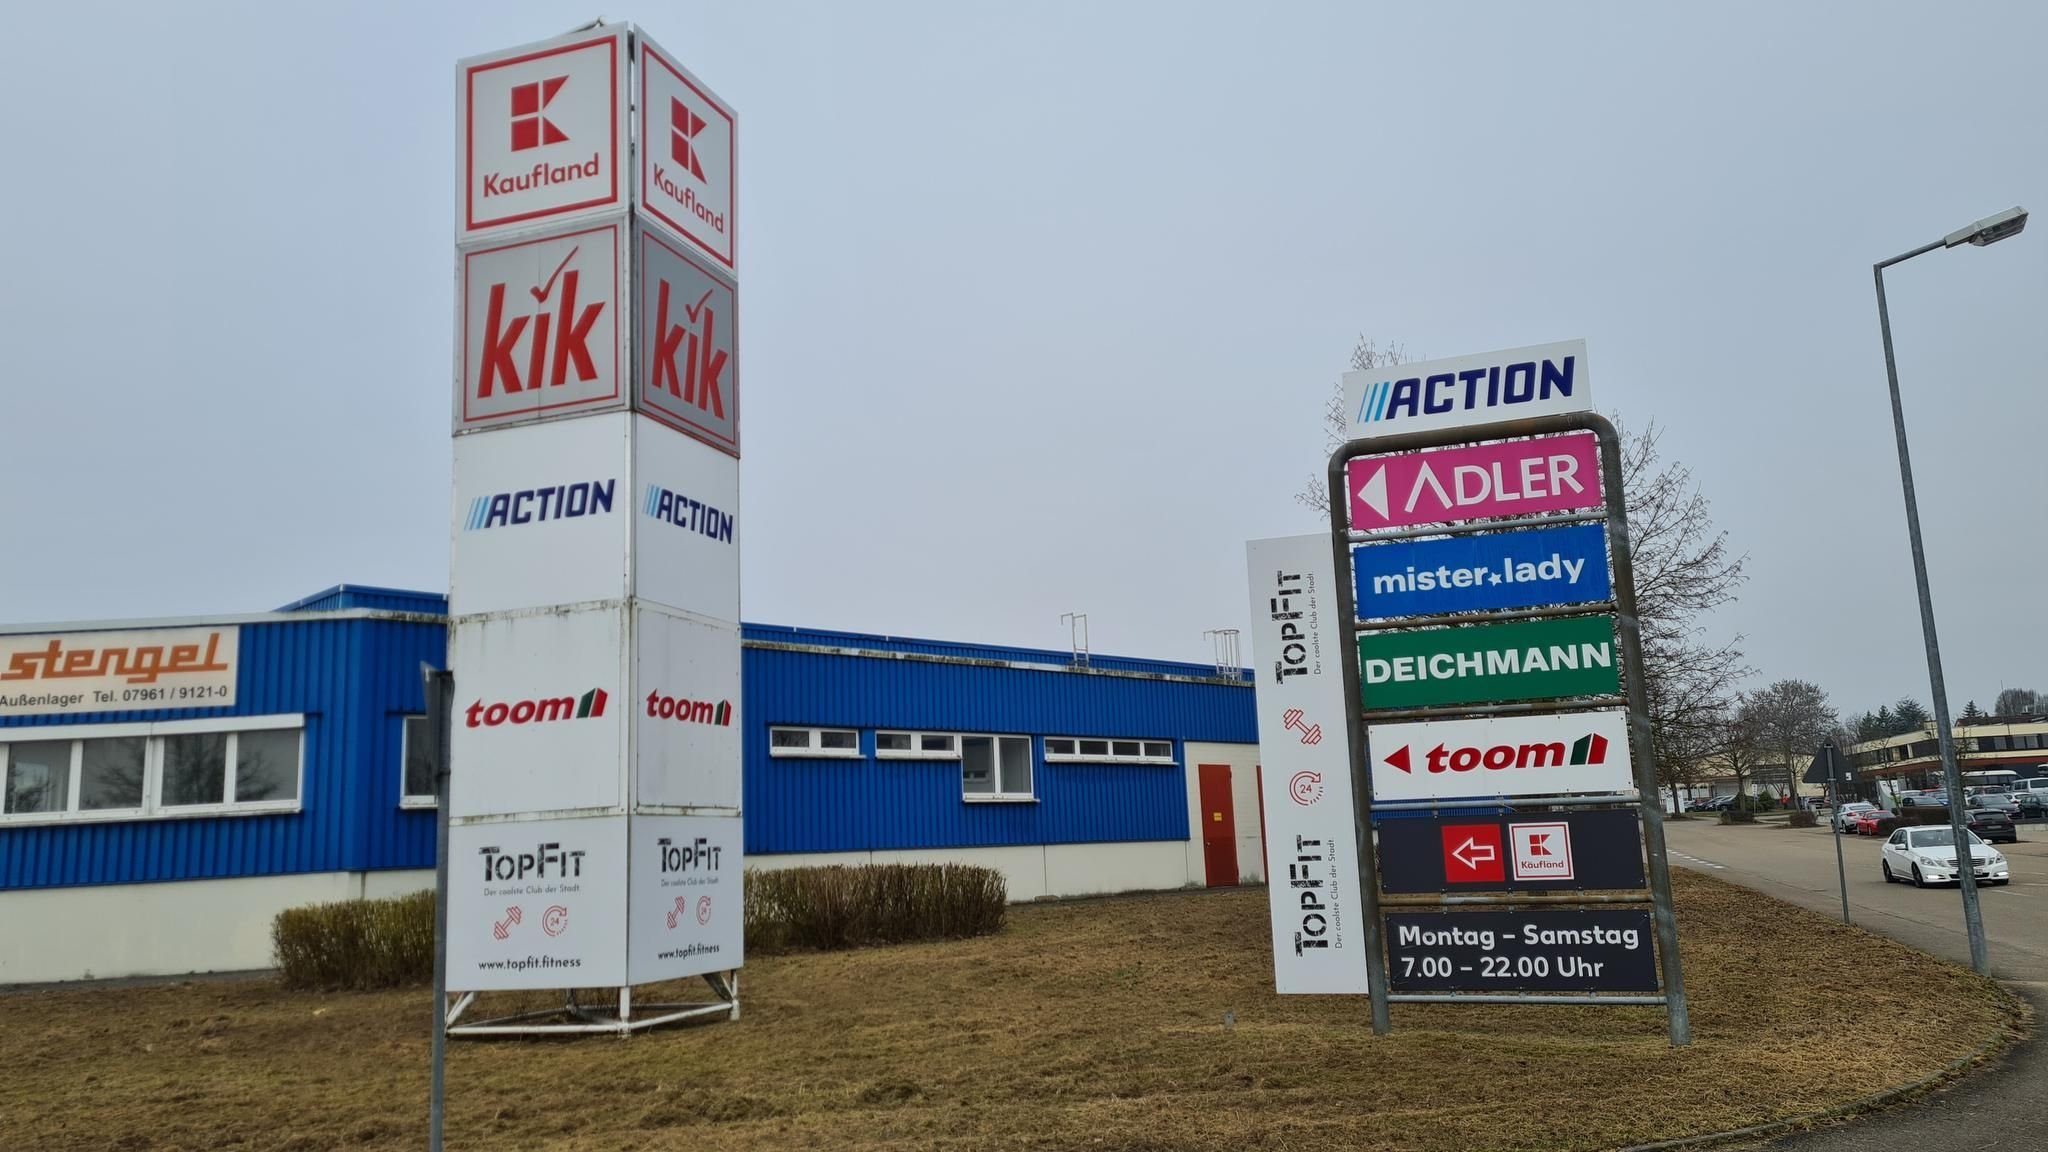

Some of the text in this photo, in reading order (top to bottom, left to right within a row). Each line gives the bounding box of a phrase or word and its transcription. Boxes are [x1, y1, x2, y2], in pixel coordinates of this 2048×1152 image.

[483, 152, 600, 198] Kaufland
[653, 163, 724, 234] Kaufland
[1385, 356, 1575, 420] ACTION
[1404, 454, 1585, 514] ADLER
[485, 478, 616, 529] ACTION
[655, 487, 734, 544] ACTION
[1373, 553, 1585, 594] mister lady
[1306, 573, 1321, 675] Der coolste Club der Stadt
[0, 632, 228, 684] stengel
[1365, 641, 1612, 684] DEICHMANN
[0, 693, 84, 707] Außenlager
[93, 690, 118, 703] Tel.
[122, 688, 166, 702] 07961
[179, 685, 228, 699] 9121-0
[465, 696, 575, 729] toom
[646, 688, 714, 725] toom
[1425, 742, 1566, 774] toom
[1300, 784, 1313, 794] 24
[1521, 860, 1564, 869] Kaufland
[484, 888, 496, 896] Der
[526, 885, 543, 895] Club
[545, 885, 557, 893] der
[559, 884, 580, 892] Stadt
[1327, 839, 1343, 949] Der coolste Club der Stadt
[550, 917, 560, 927] 24
[1399, 925, 1495, 951] Montag
[1523, 924, 1639, 950] Samstag
[478, 955, 582, 972] www.topfit.fitness
[658, 942, 720, 960] www.topfit.fitness
[1400, 956, 1452, 978] 7.00
[1480, 956, 1549, 978] 22.00
[1557, 956, 1604, 977] Uhr
